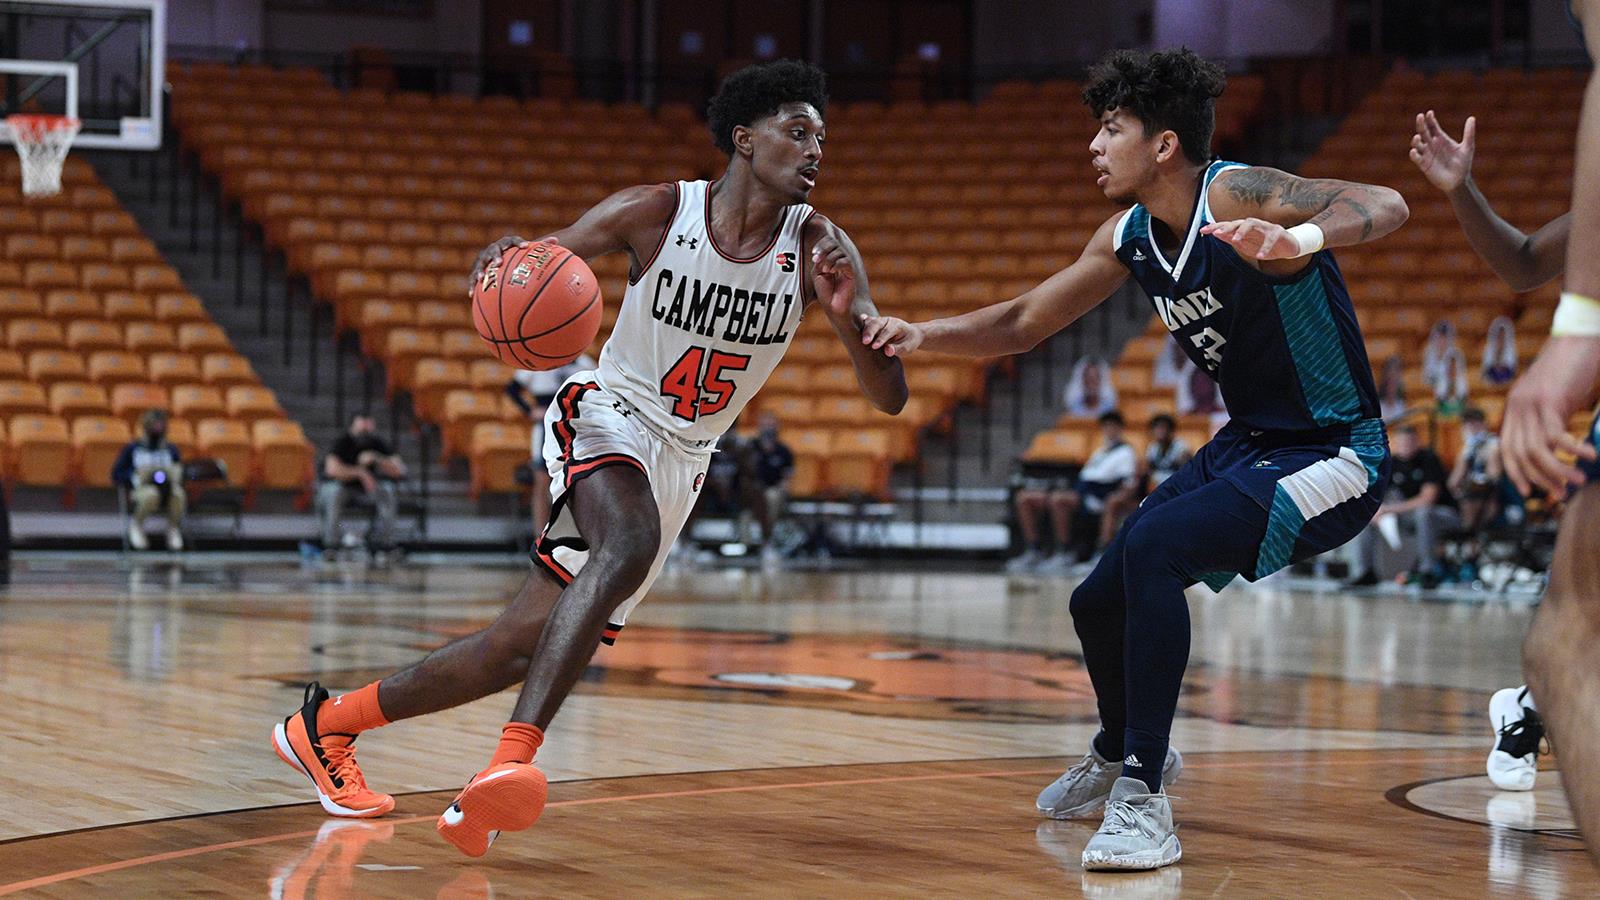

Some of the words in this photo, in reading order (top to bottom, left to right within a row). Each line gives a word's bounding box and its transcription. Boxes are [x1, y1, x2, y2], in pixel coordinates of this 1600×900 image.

[652, 268, 793, 345] CAMPBELL
[1153, 286, 1224, 332] UNC
[660, 345, 752, 423] 45
